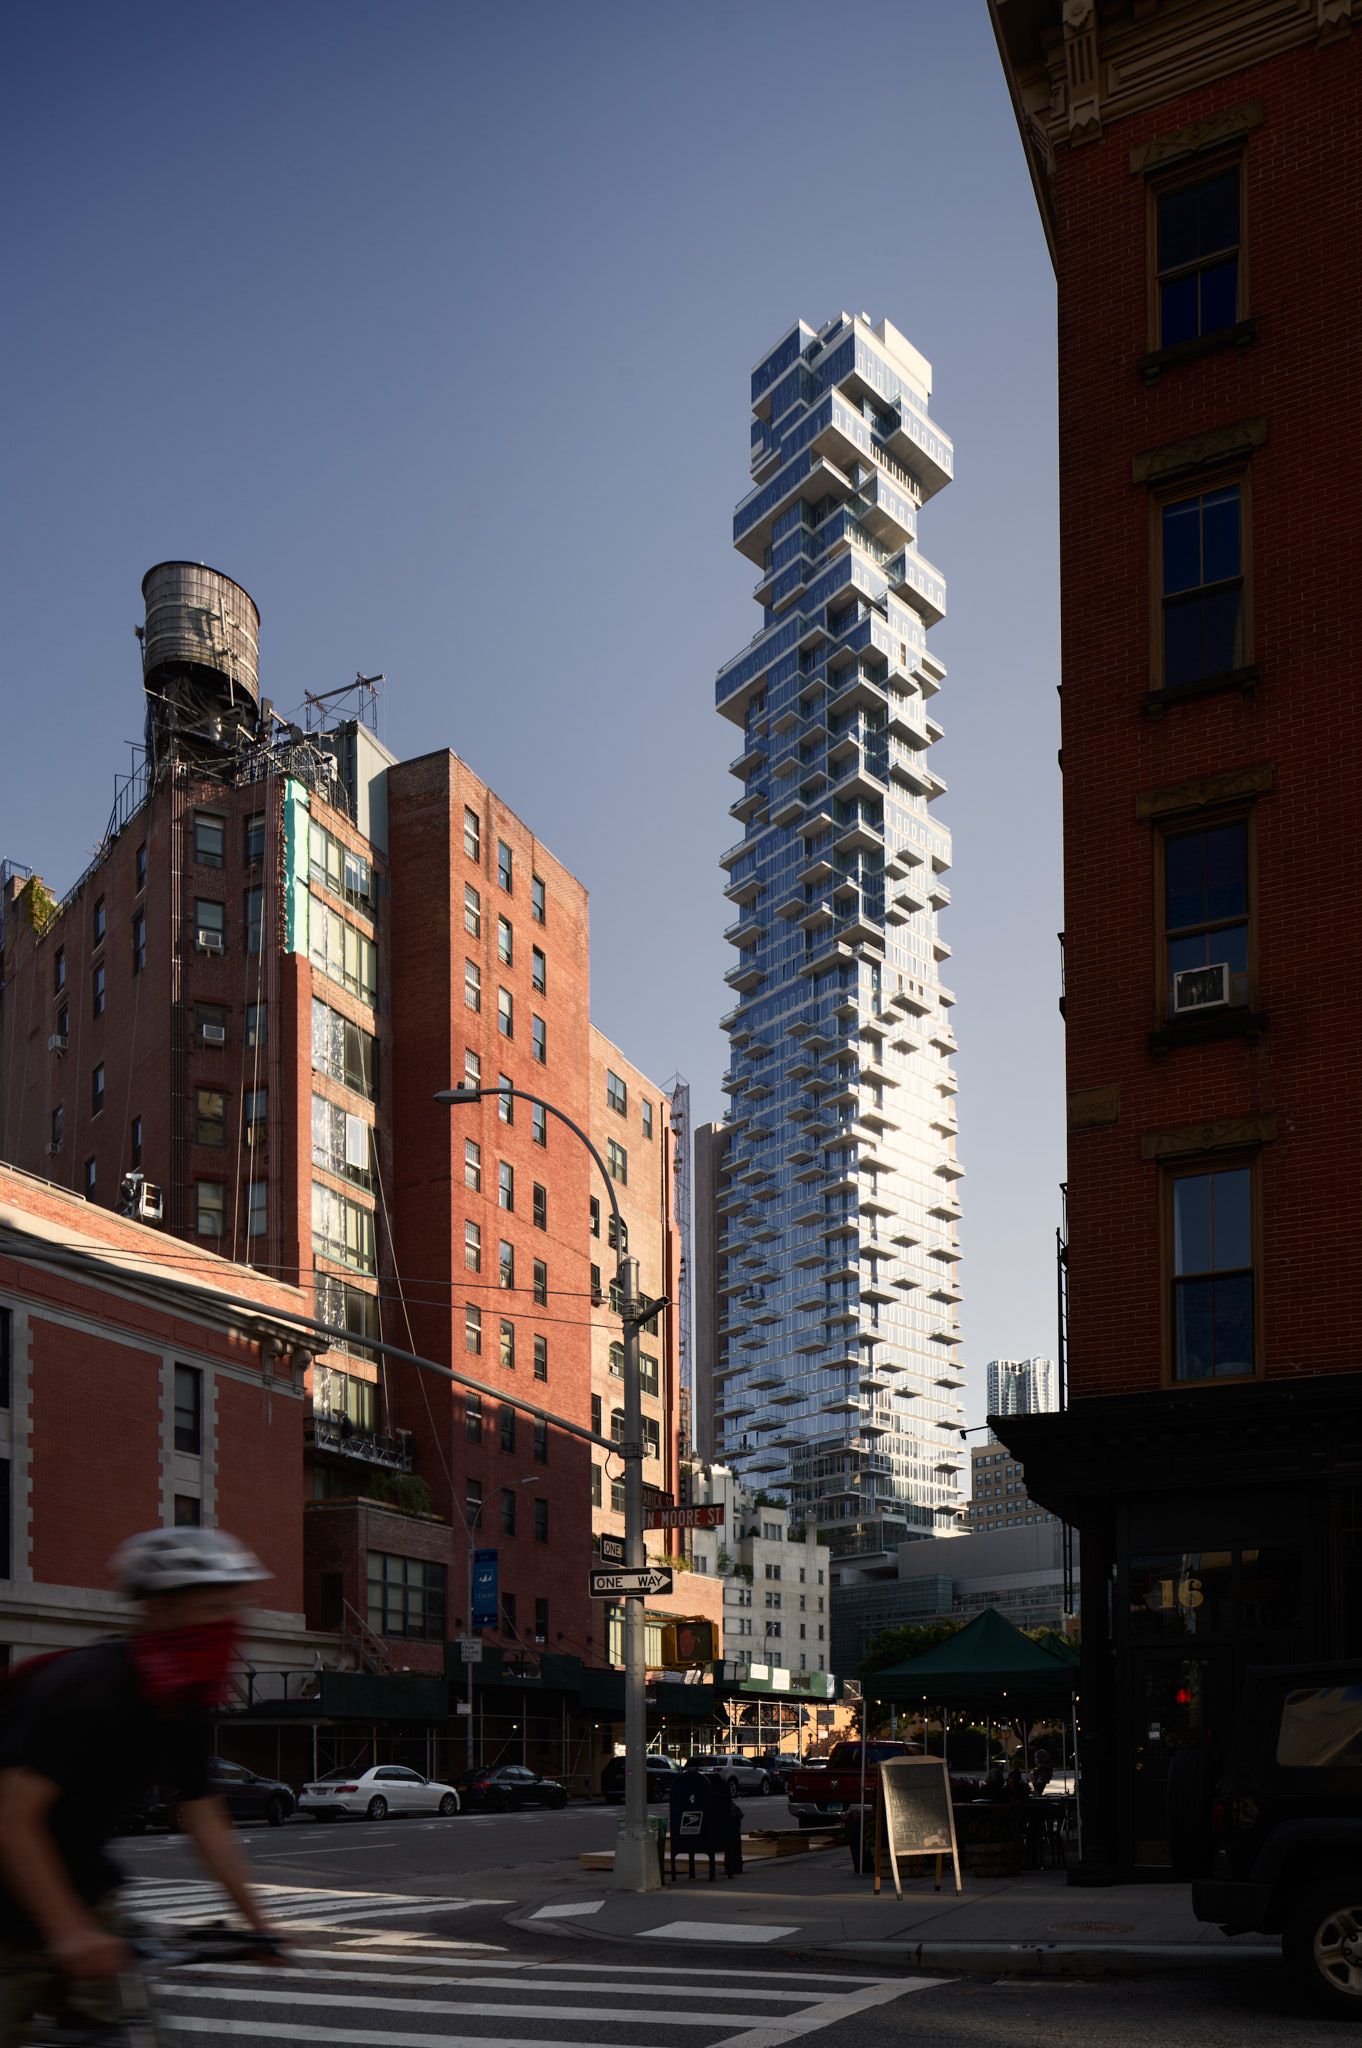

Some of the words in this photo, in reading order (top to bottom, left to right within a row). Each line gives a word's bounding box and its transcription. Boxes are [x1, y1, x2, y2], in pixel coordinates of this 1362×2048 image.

[643, 1488, 662, 1506] ARICK
[665, 1495, 673, 1506] ST
[661, 1508, 701, 1528] MOORE
[708, 1506, 721, 1525] ST
[605, 1543, 620, 1555] ONE
[597, 1577, 623, 1588] ONE
[637, 1576, 663, 1587] WAY
[1157, 1577, 1205, 1608] 16
